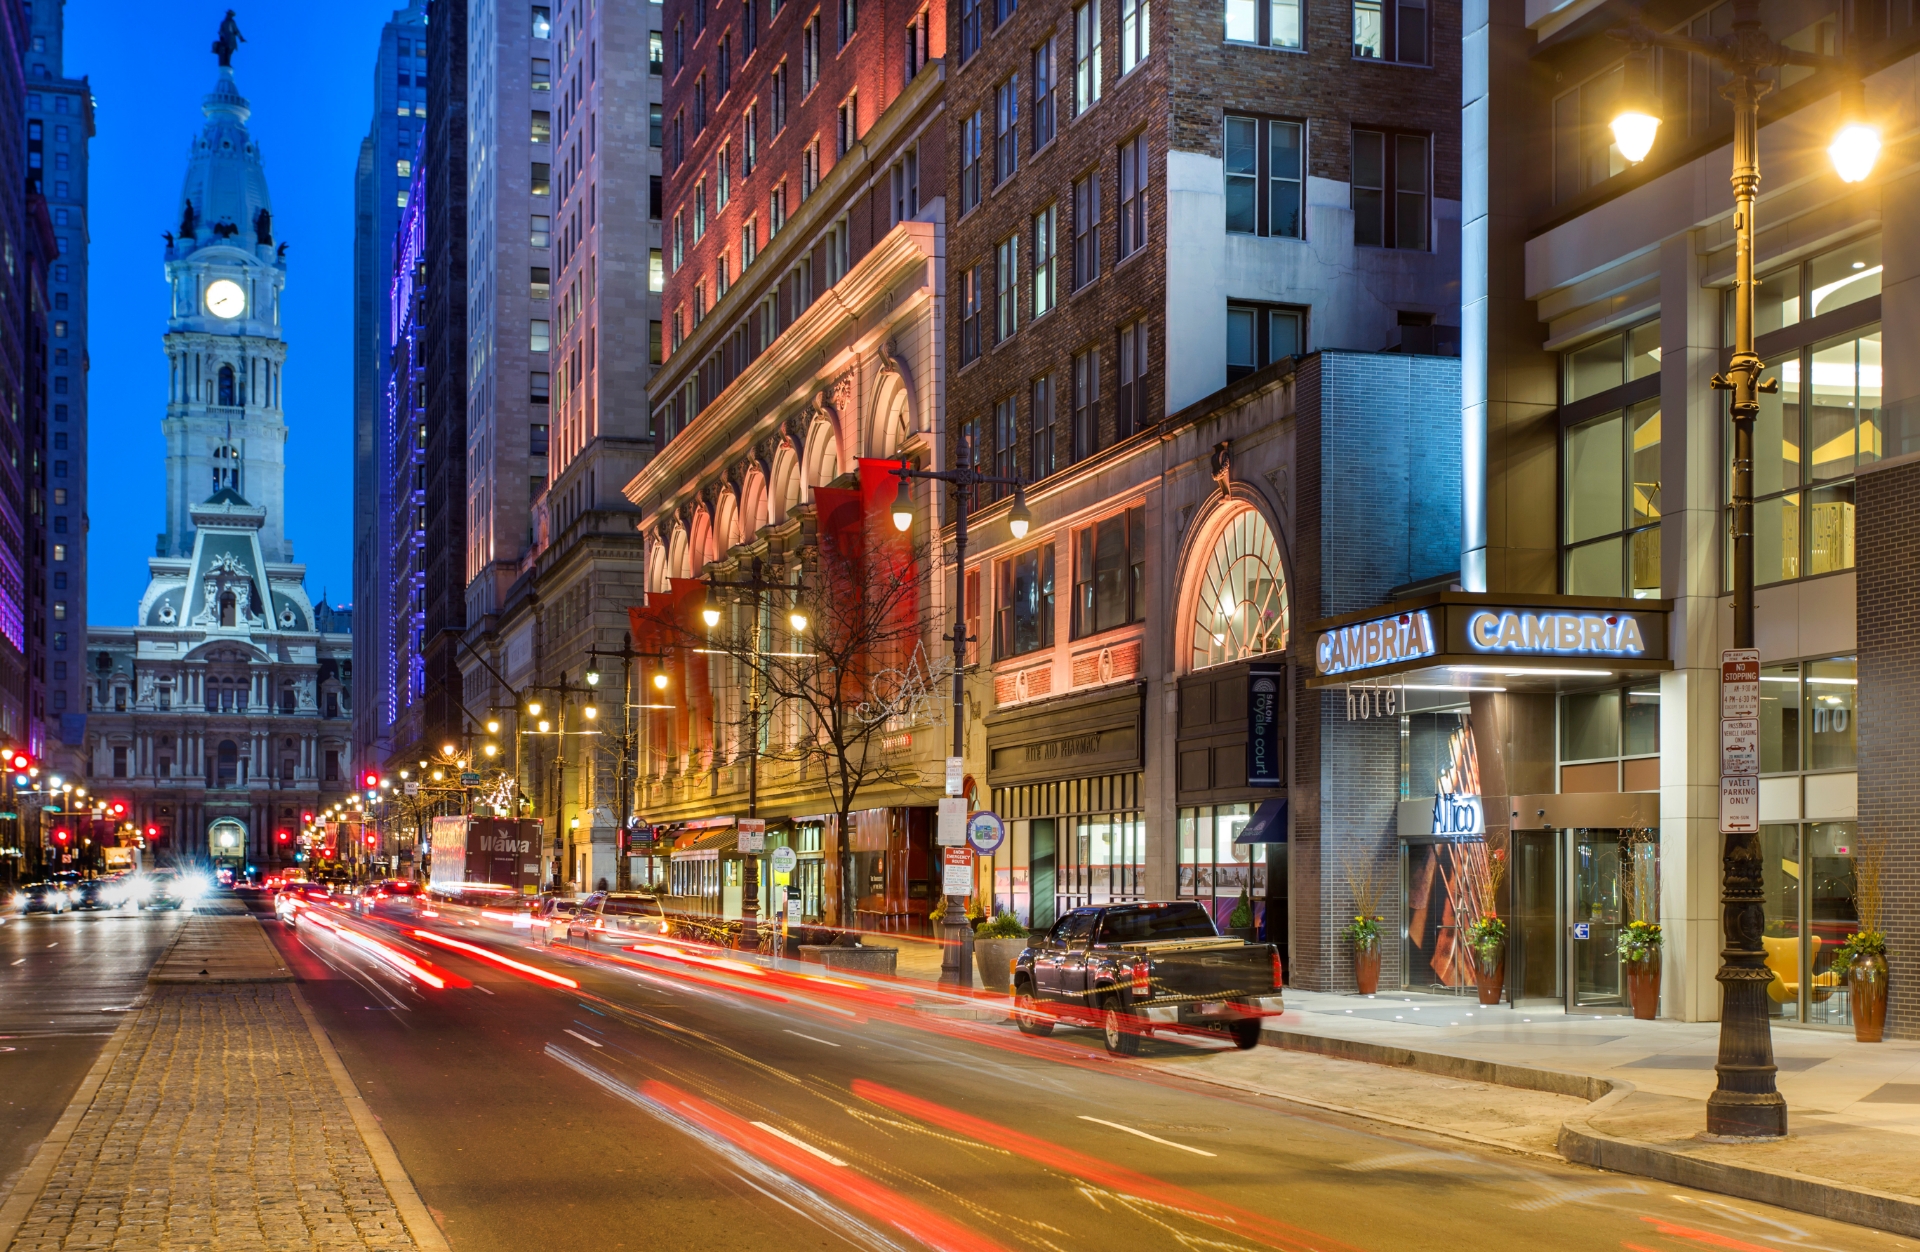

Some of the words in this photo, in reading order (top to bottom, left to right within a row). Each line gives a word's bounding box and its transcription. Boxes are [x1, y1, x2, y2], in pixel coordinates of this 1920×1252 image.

[1735, 663, 1746, 671] NO
[1725, 672, 1757, 681] STOPPING
[1265, 694, 1273, 723] SALON
[1252, 693, 1268, 736] royale
[1255, 742, 1268, 775] court
[1728, 779, 1751, 787] VALET
[1723, 788, 1756, 796] PARKING
[1730, 797, 1750, 805] ONLY
[480, 835, 530, 853] Wawa
